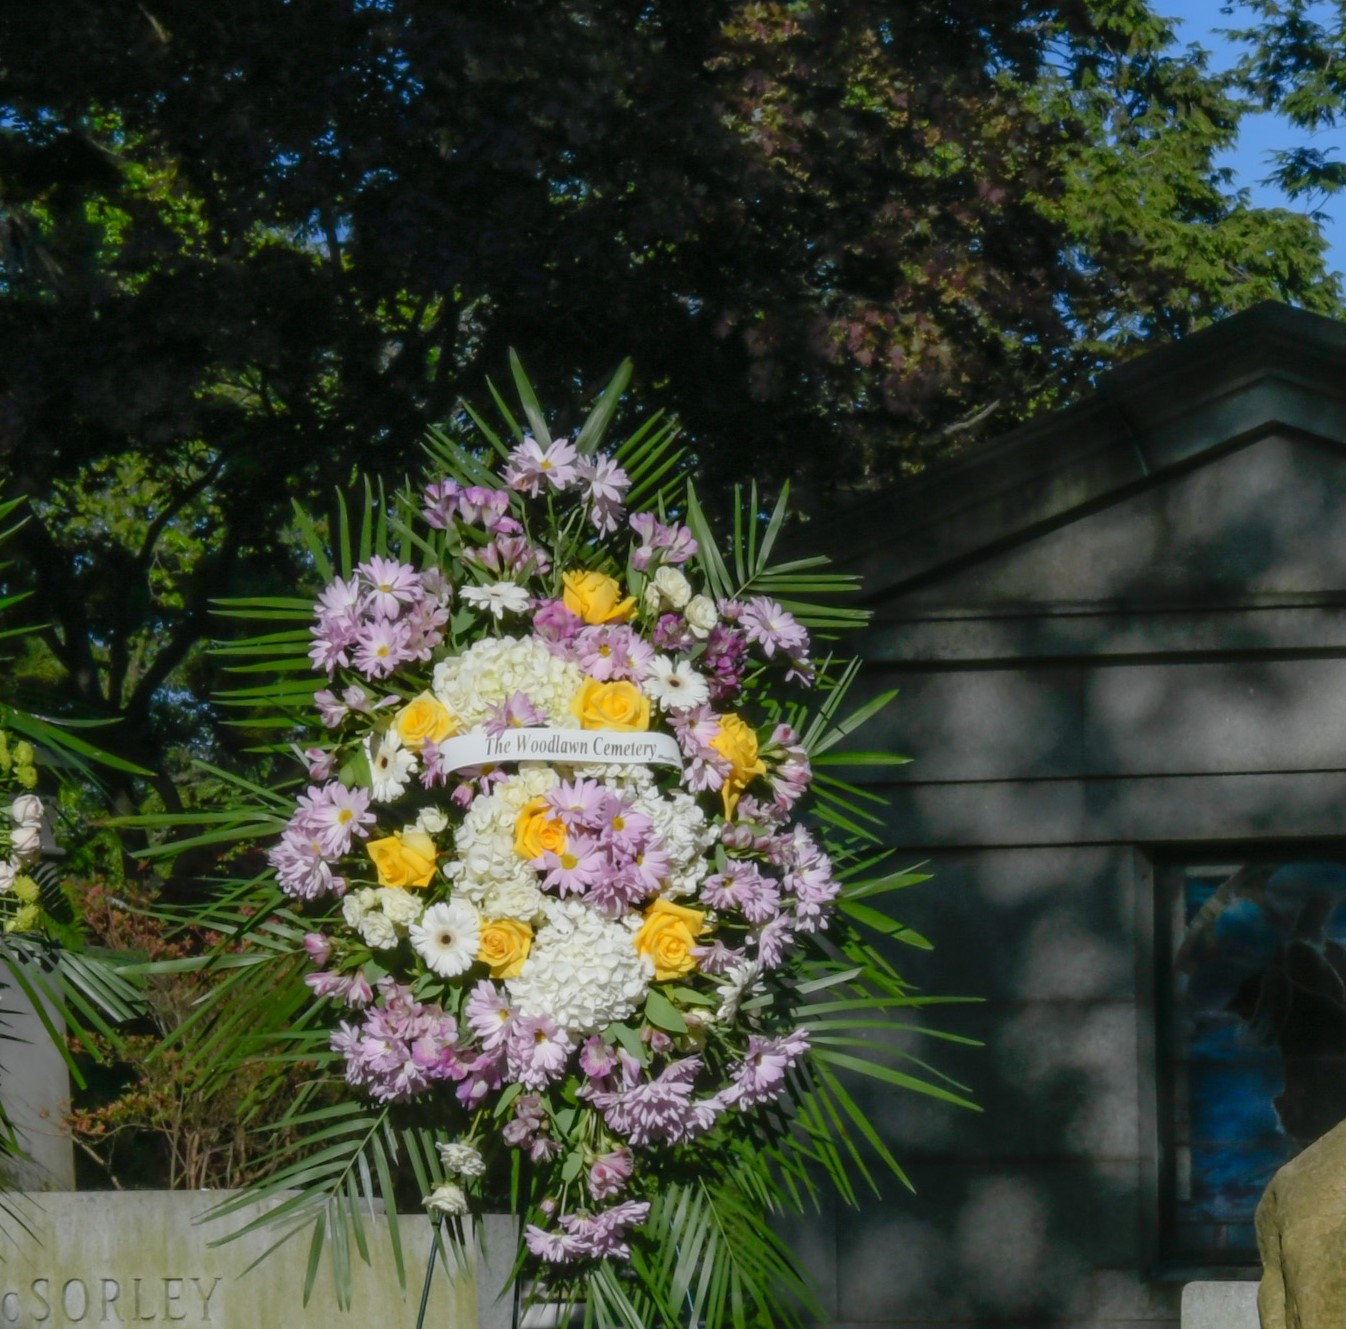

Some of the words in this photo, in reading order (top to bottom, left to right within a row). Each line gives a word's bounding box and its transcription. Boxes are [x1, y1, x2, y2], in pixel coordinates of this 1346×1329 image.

[485, 737, 511, 756] The
[516, 735, 588, 755] Woodlawn
[592, 736, 658, 761] Cemetery
